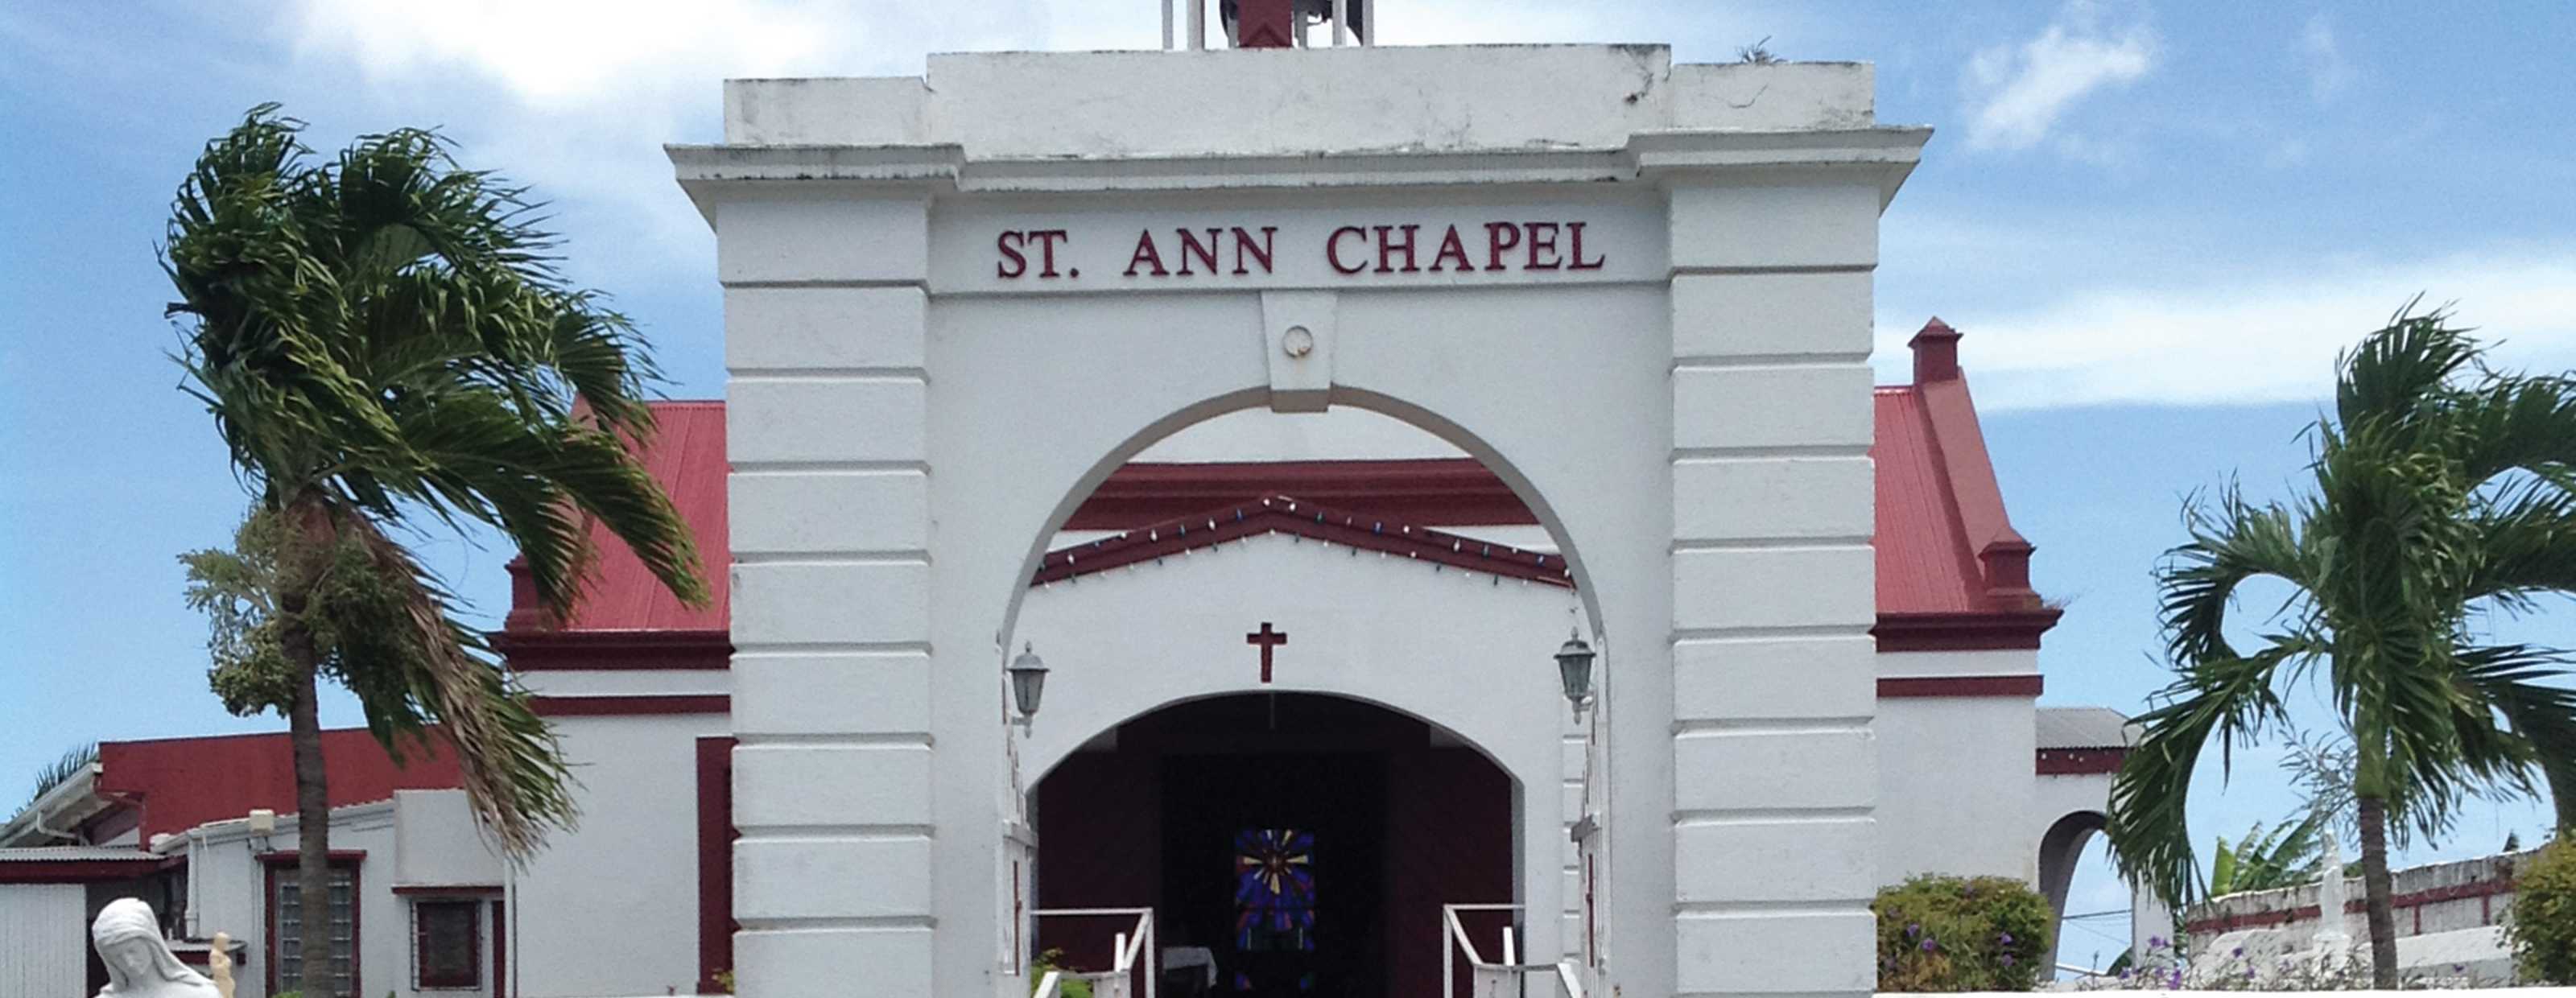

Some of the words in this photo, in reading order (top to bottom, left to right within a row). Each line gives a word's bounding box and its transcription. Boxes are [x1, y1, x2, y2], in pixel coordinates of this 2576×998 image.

[997, 229, 1080, 279] ST.
[1123, 227, 1279, 277] ANN
[1326, 221, 1606, 274] CHAPEL
